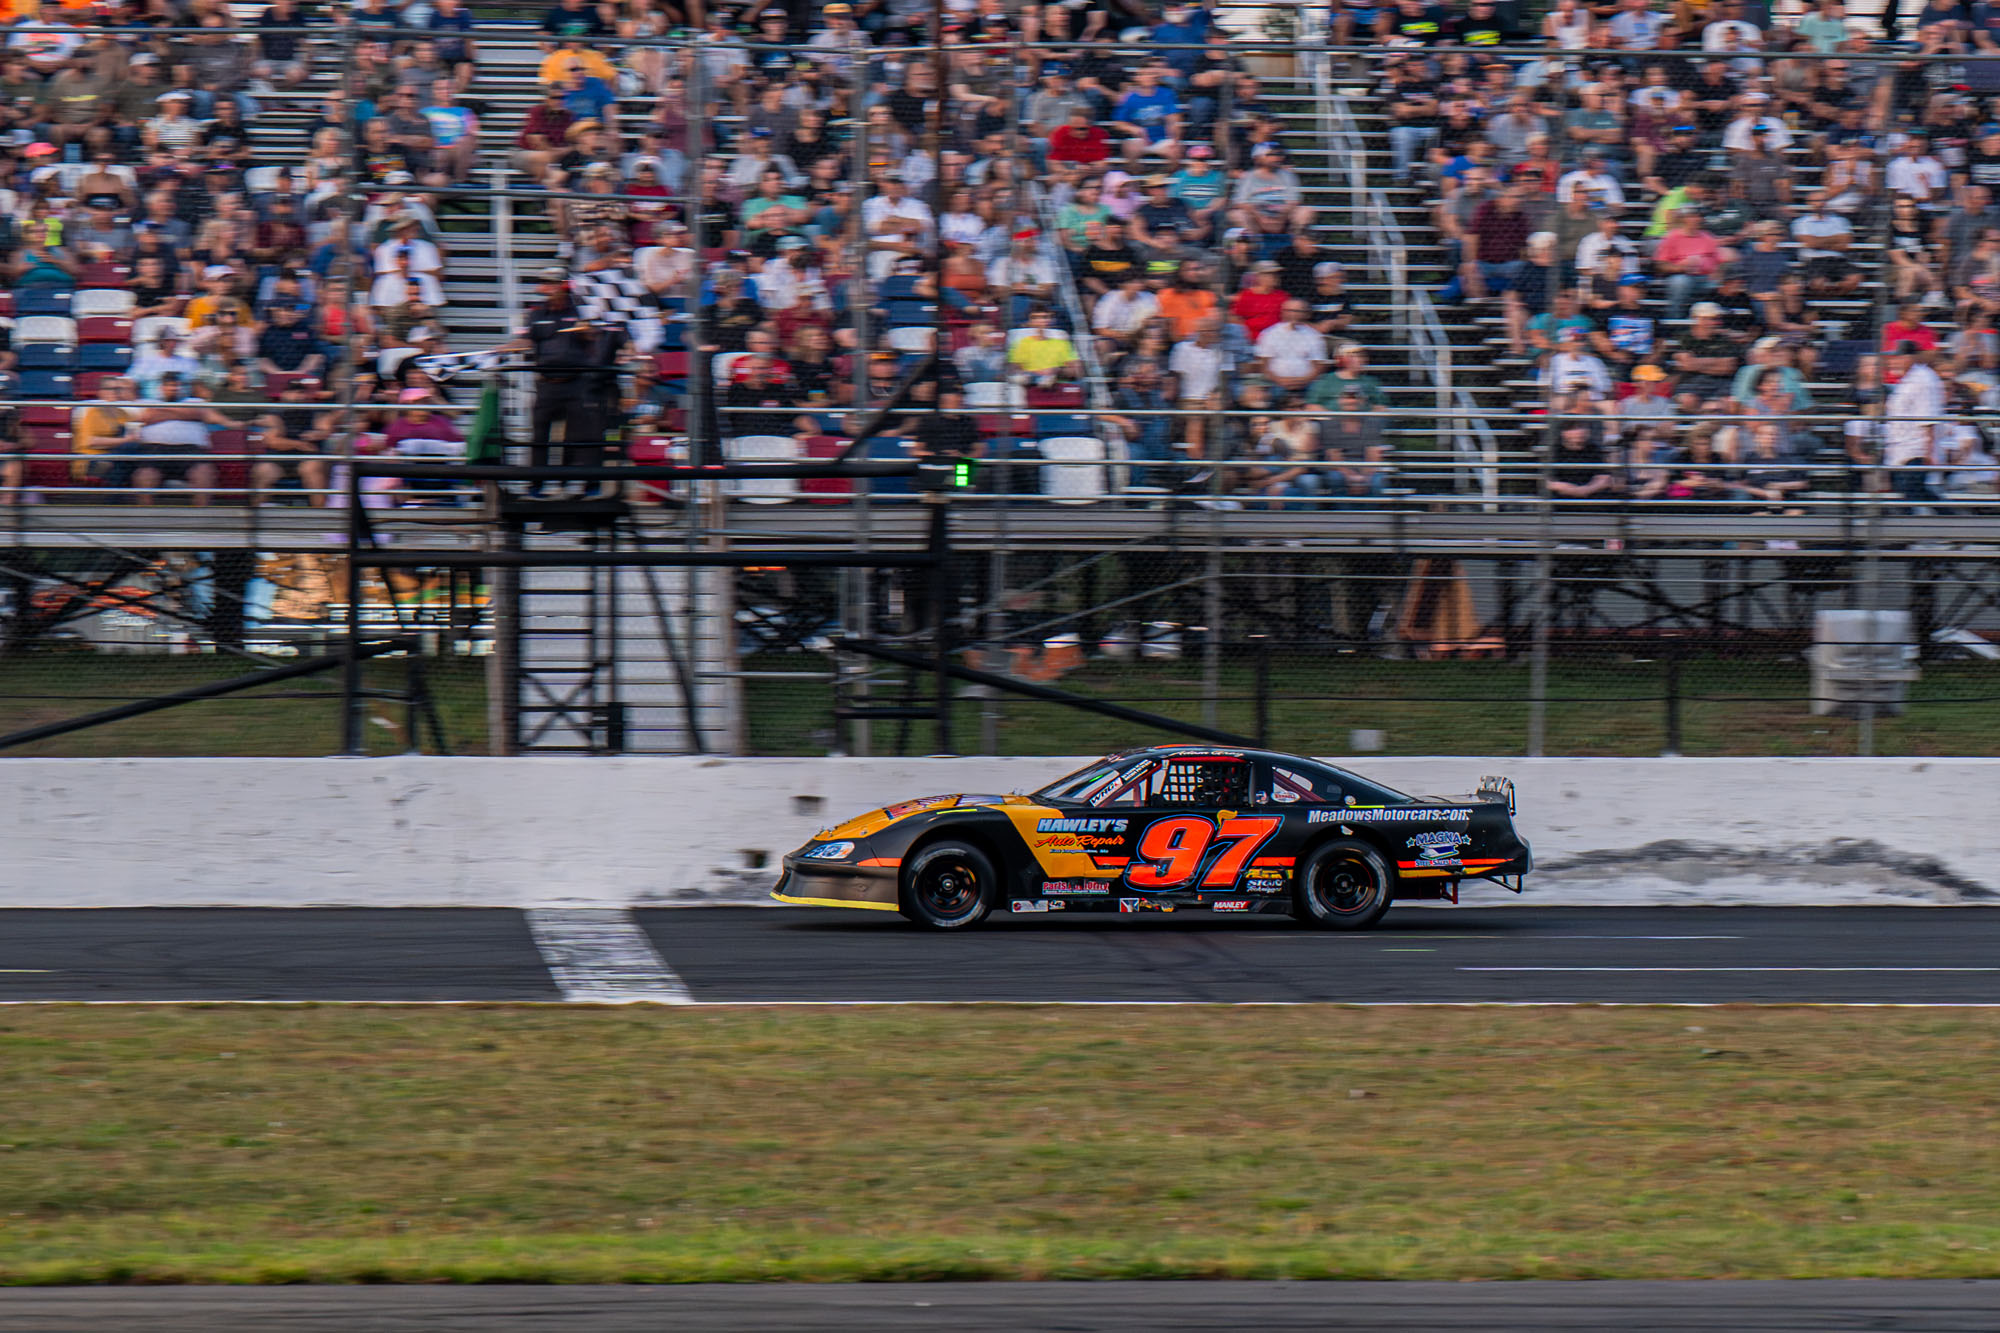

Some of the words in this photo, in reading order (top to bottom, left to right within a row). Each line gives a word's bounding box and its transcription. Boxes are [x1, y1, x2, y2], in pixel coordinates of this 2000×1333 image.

[1308, 808, 1473, 823] MeadowsMotorcars.com
[1036, 818, 1128, 832] HAWLEY'S
[1034, 834, 1076, 848] Auto
[1075, 834, 1125, 848] Repair
[1415, 831, 1463, 846] MAGNA
[1126, 814, 1284, 891] 97
